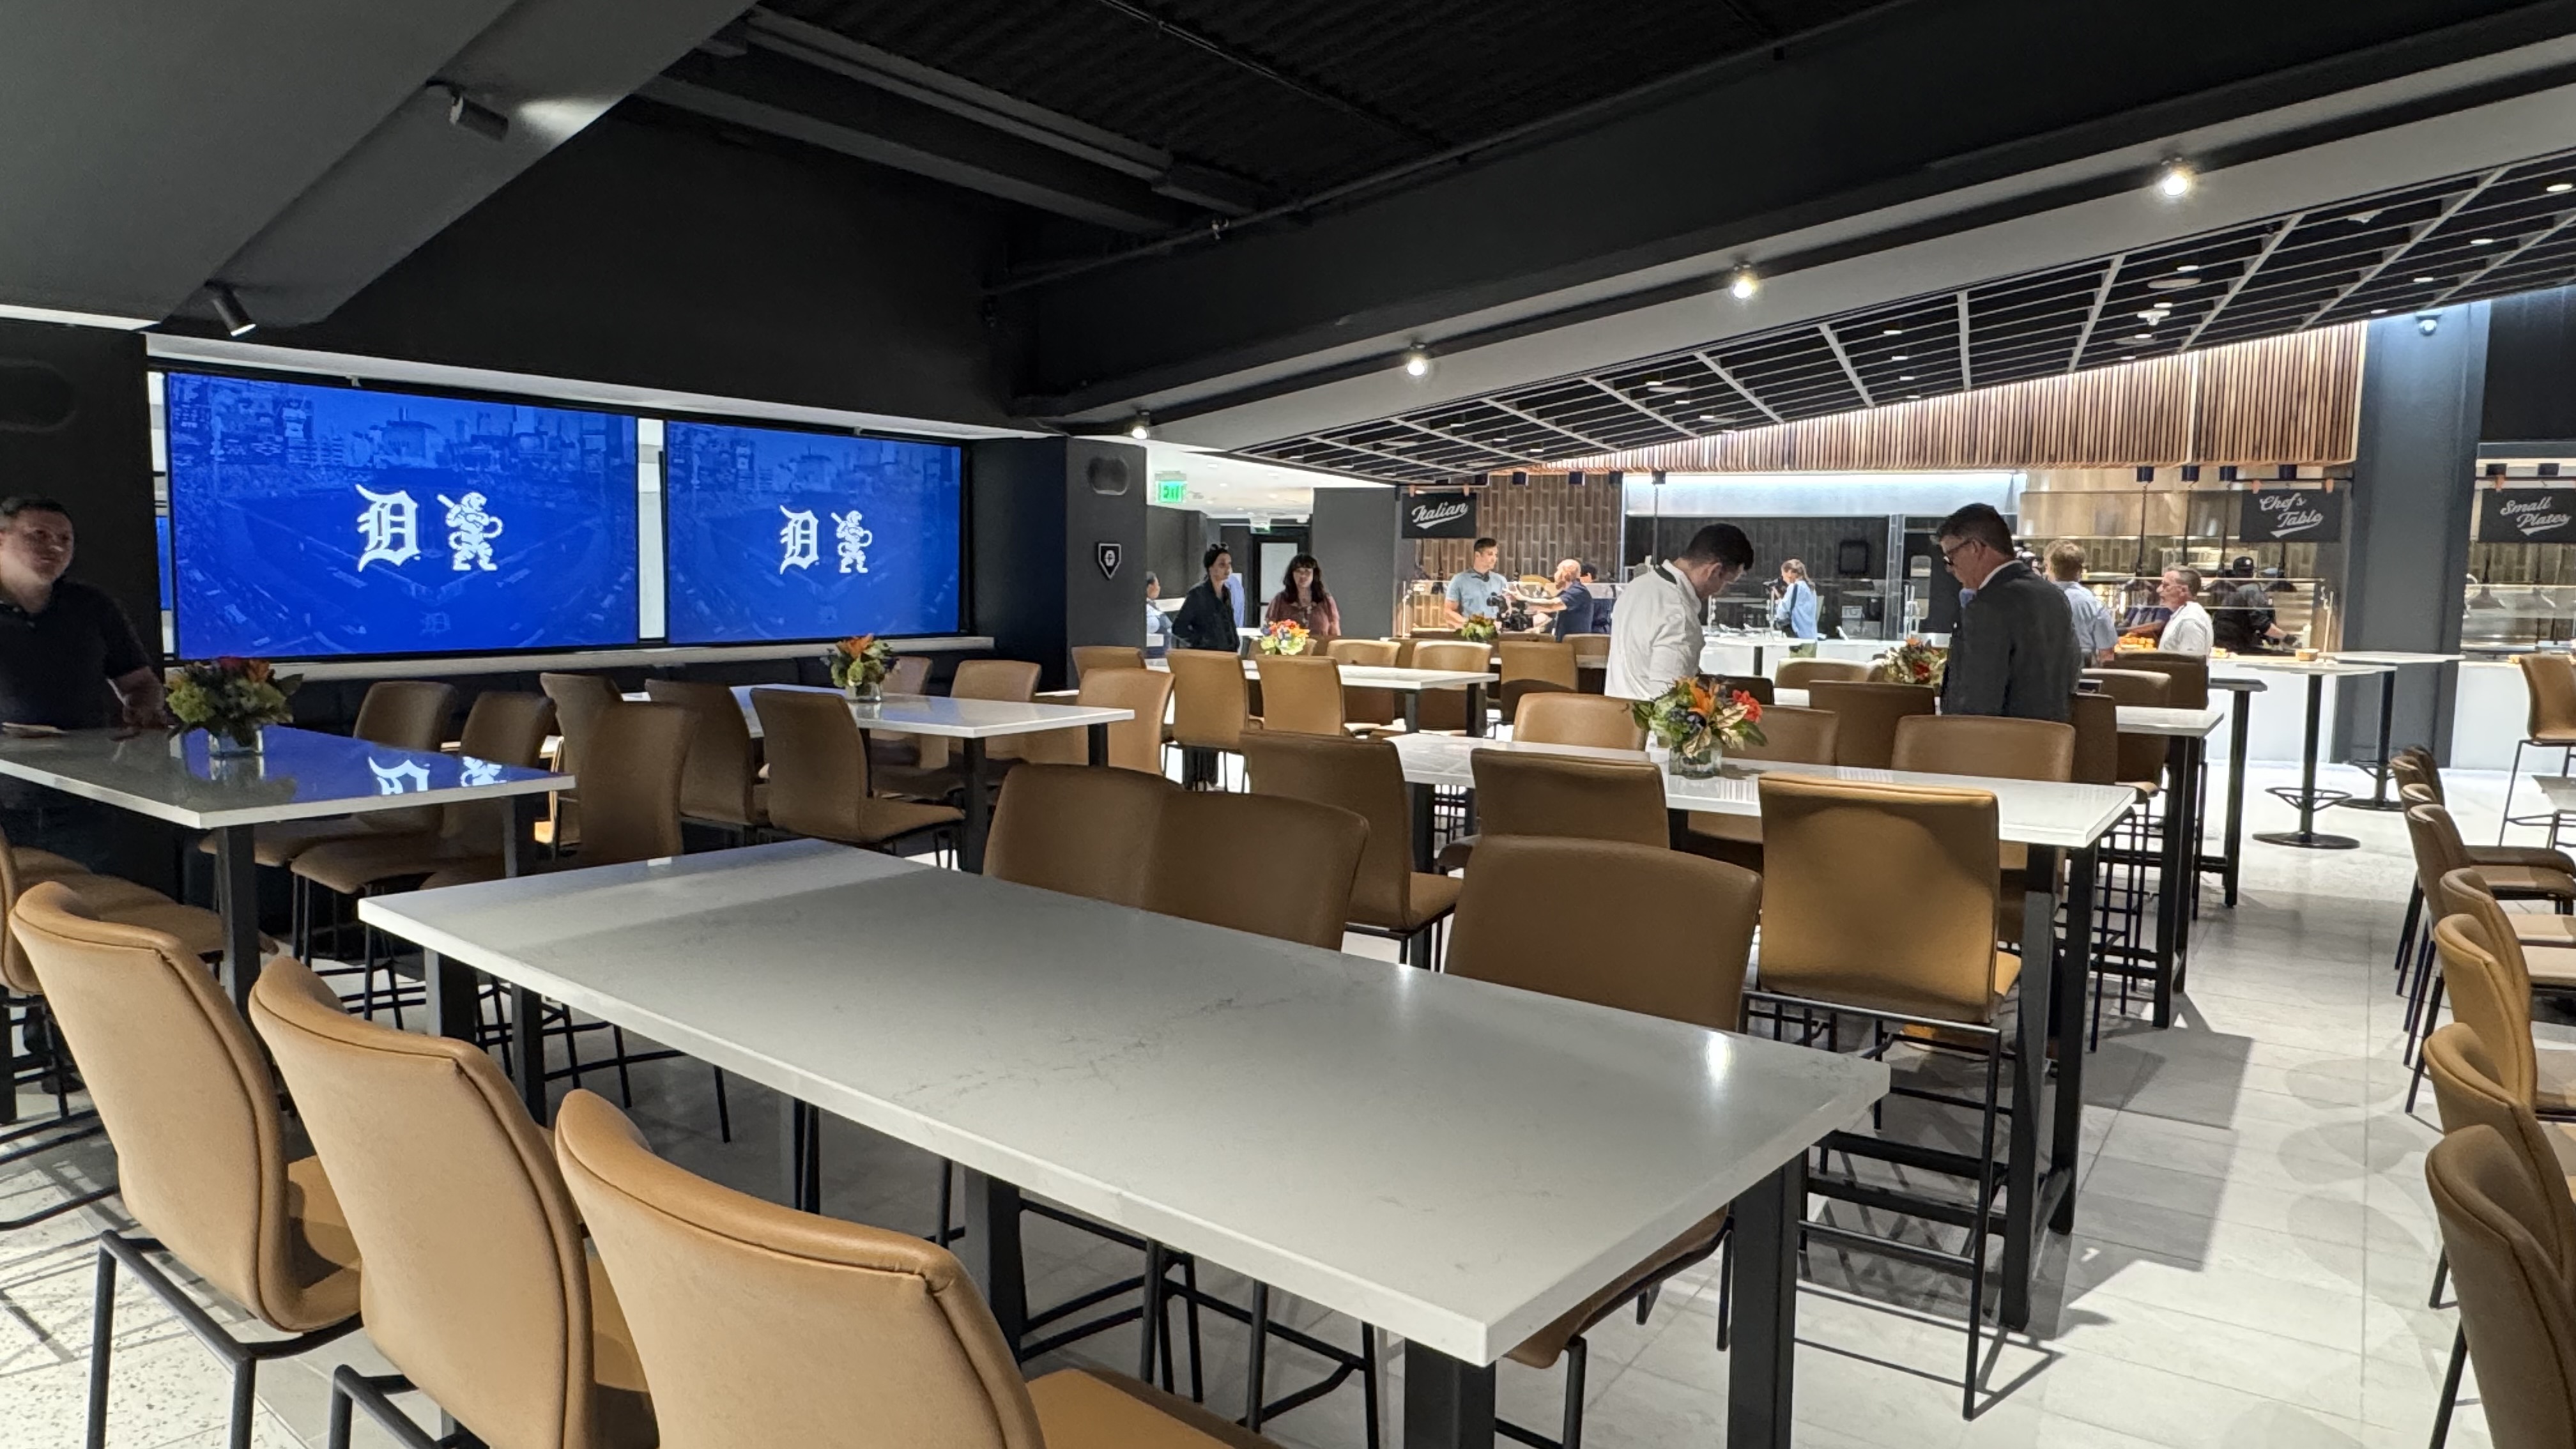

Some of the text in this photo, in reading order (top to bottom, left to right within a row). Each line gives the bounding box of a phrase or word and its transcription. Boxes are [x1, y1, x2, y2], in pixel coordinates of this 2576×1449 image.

[1411, 501, 1469, 523] Italian
[2499, 496, 2553, 516] Small
[355, 483, 421, 572] D
[2277, 509, 2324, 528] Table
[2516, 512, 2572, 528] Plates
[779, 504, 819, 575] D
